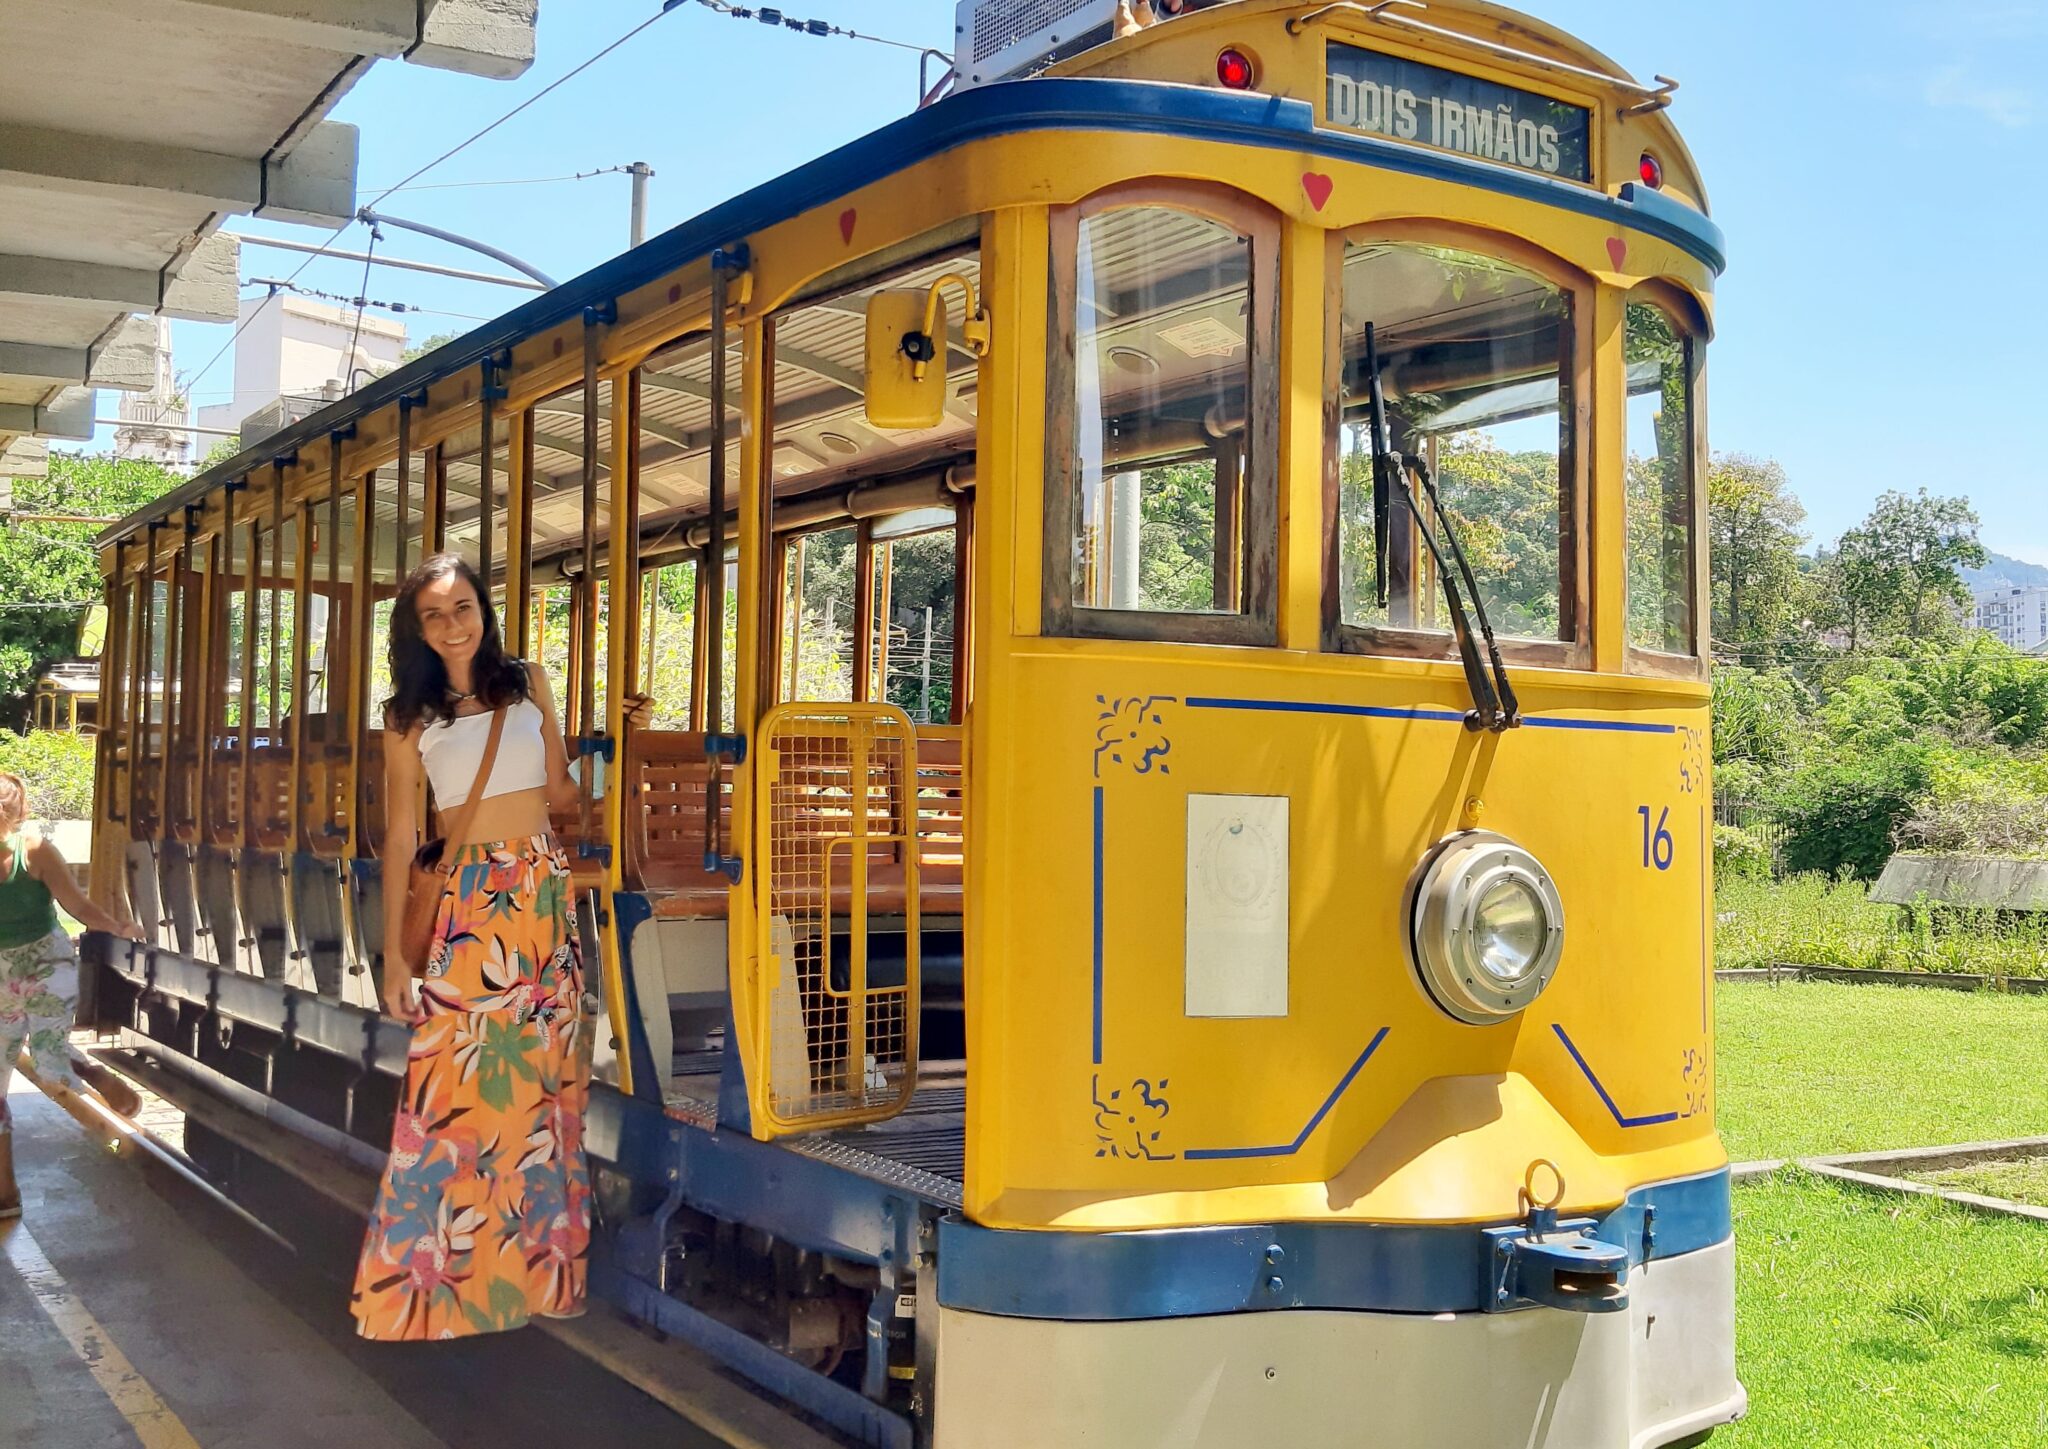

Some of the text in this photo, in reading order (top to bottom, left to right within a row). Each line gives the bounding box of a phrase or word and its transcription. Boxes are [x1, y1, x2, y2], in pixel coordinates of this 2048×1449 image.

[1332, 72, 1560, 173] DOIS IRMÃOS
[1637, 805, 1673, 871] 16
